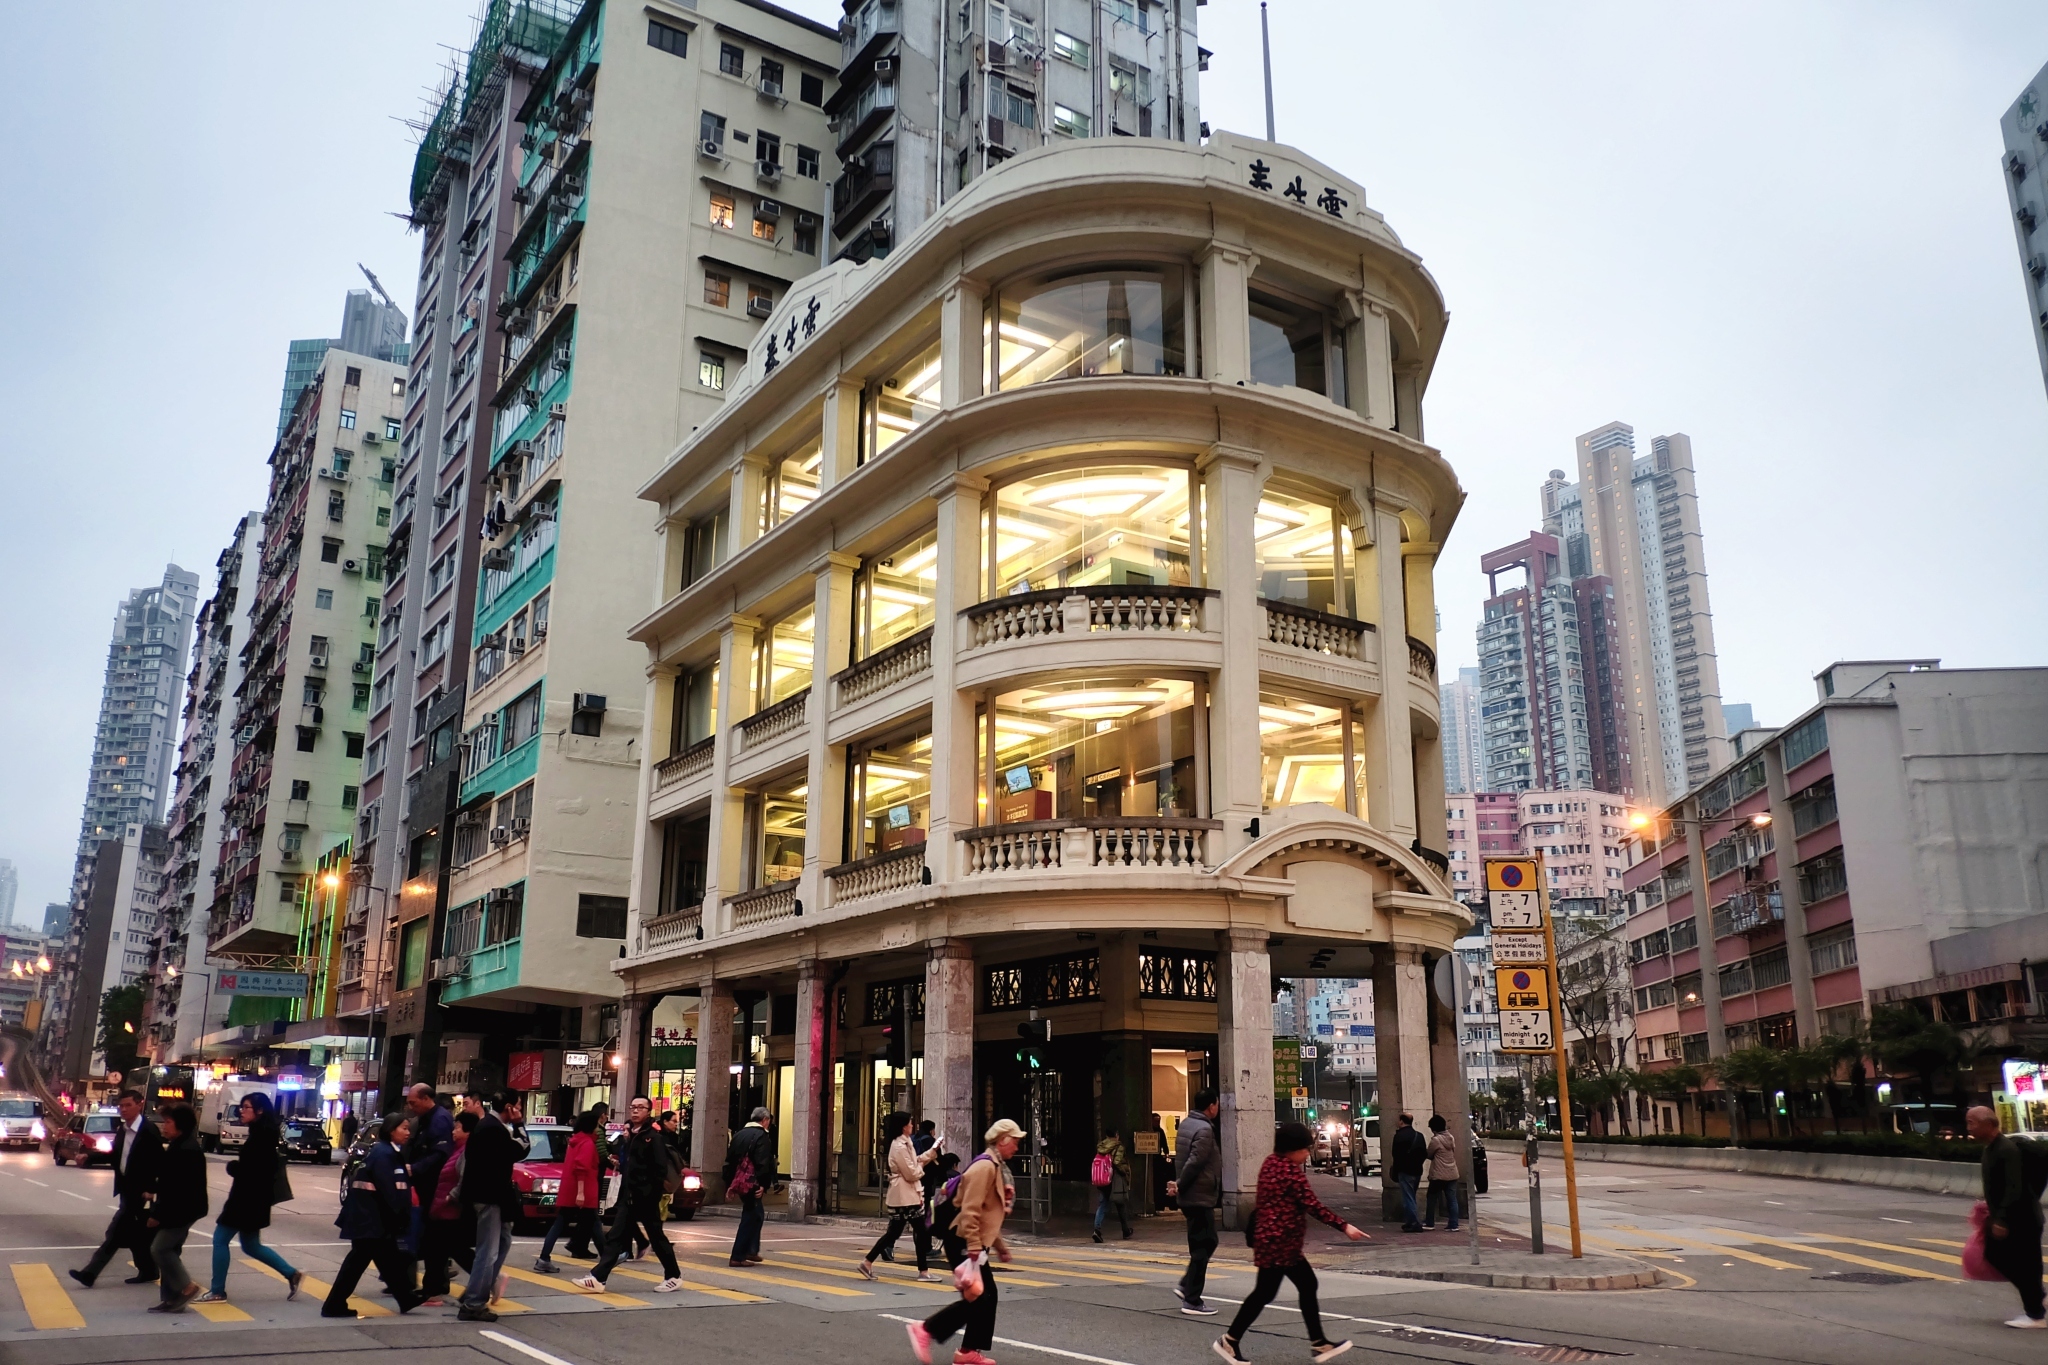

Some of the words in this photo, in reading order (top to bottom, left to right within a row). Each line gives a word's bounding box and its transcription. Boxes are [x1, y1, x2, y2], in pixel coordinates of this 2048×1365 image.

[1520, 893, 1529, 906] 7
[1501, 917, 1515, 925] 下午
[1522, 912, 1531, 925] 7
[1530, 1012, 1540, 1025] 7
[1510, 1038, 1525, 1046] 午夜
[1533, 1032, 1549, 1046] 12
